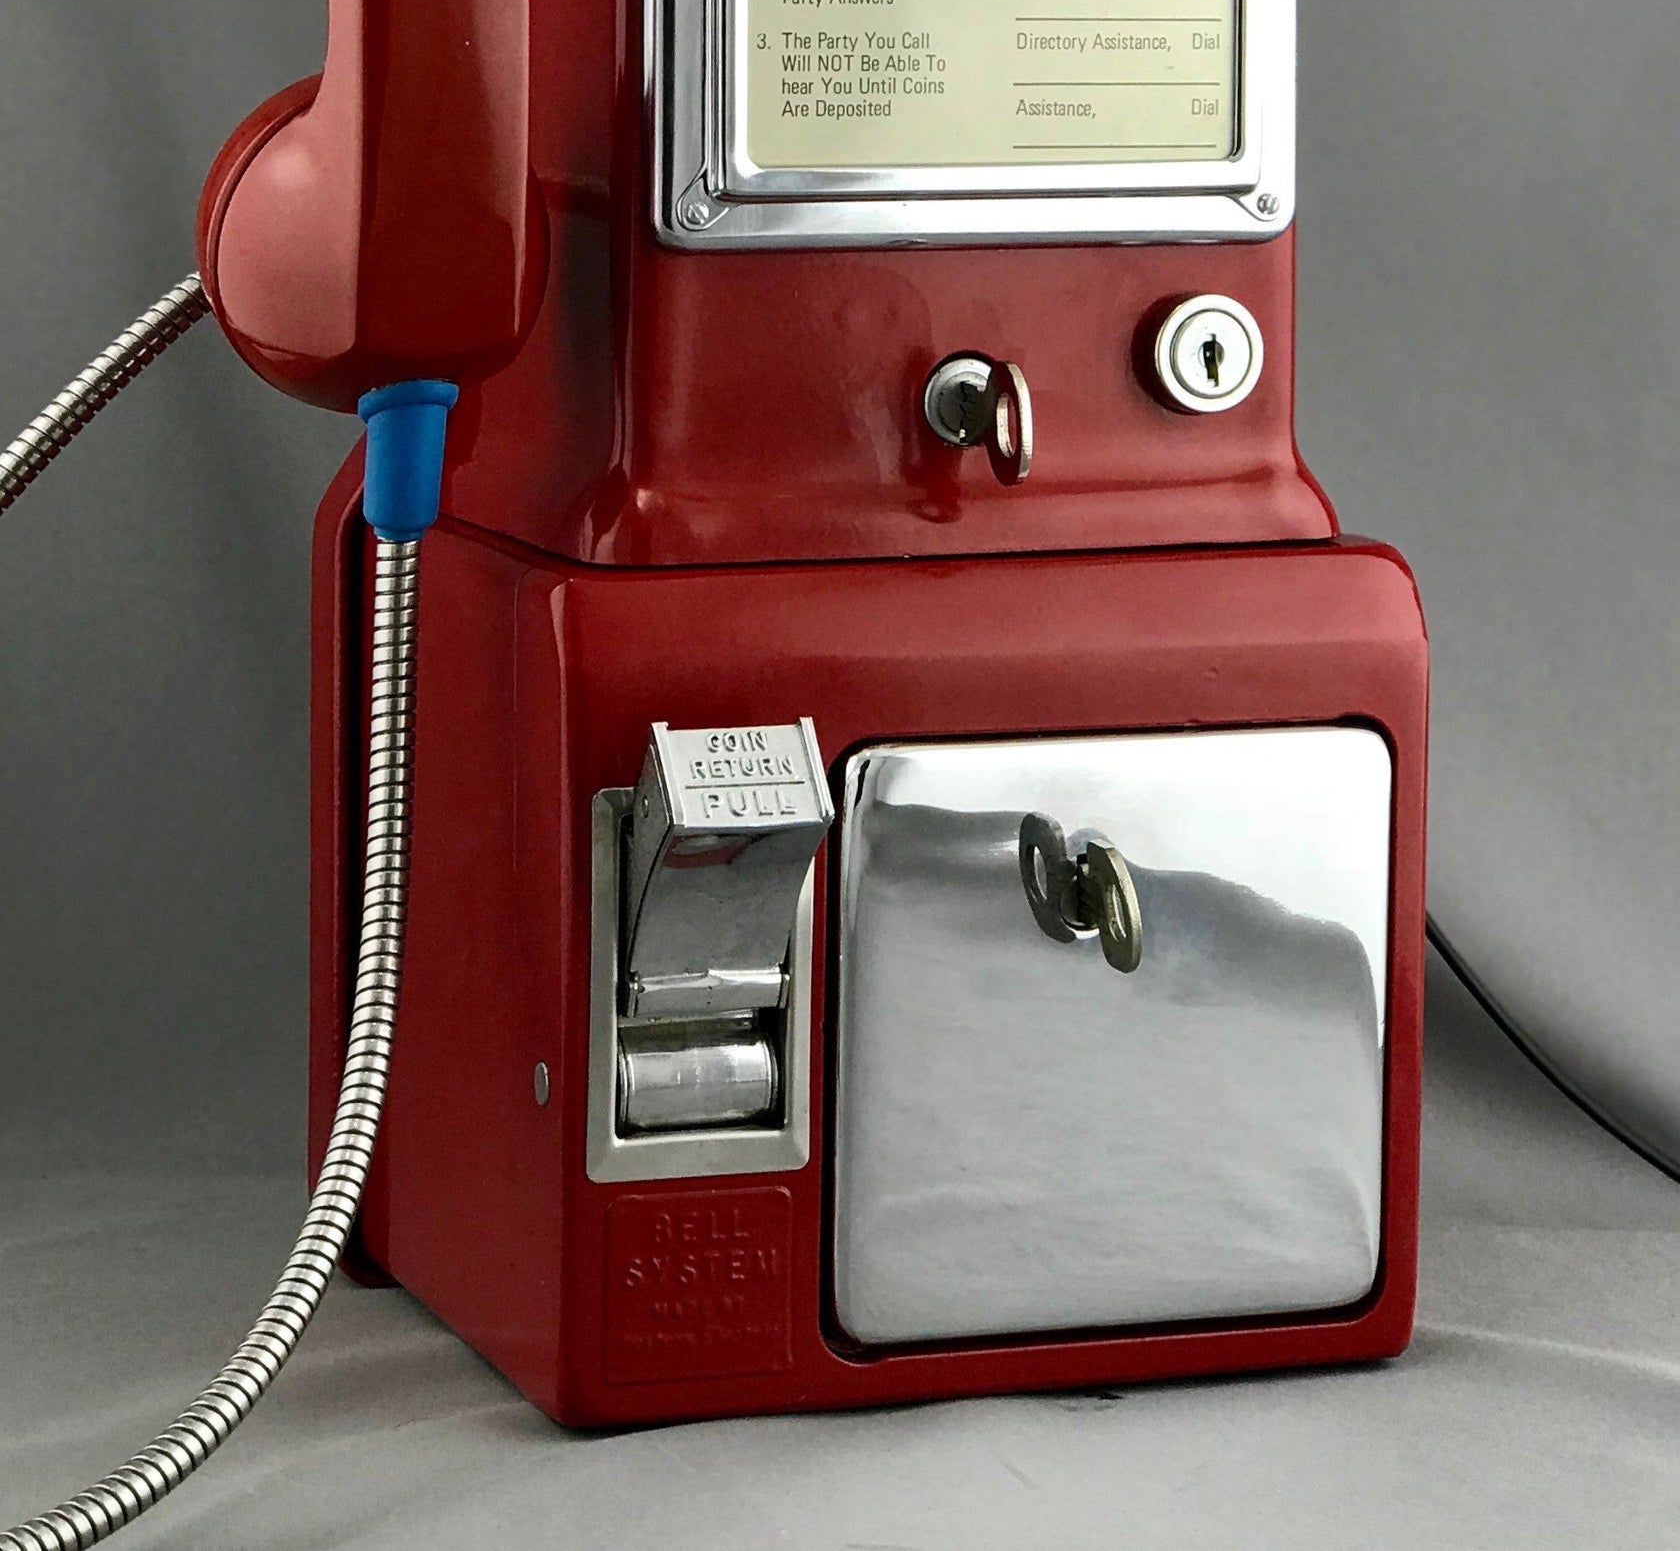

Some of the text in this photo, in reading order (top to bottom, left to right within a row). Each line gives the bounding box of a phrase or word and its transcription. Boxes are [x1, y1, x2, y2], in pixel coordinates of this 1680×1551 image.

[757, 32, 930, 53] 3. The Party You Call
[1017, 33, 1220, 54] Directory Assistance, Dial
[782, 55, 947, 73] Will NOT Be Able To
[782, 77, 945, 96] hear You Until Coins
[781, 99, 892, 121] Are Deposited
[1016, 98, 1219, 120] Assistance, Dial
[706, 730, 769, 752] COIN
[689, 755, 796, 781] RETURN
[701, 789, 798, 820] PULL
[651, 1207, 750, 1245] BELL
[622, 1247, 779, 1288] SYSTEM
